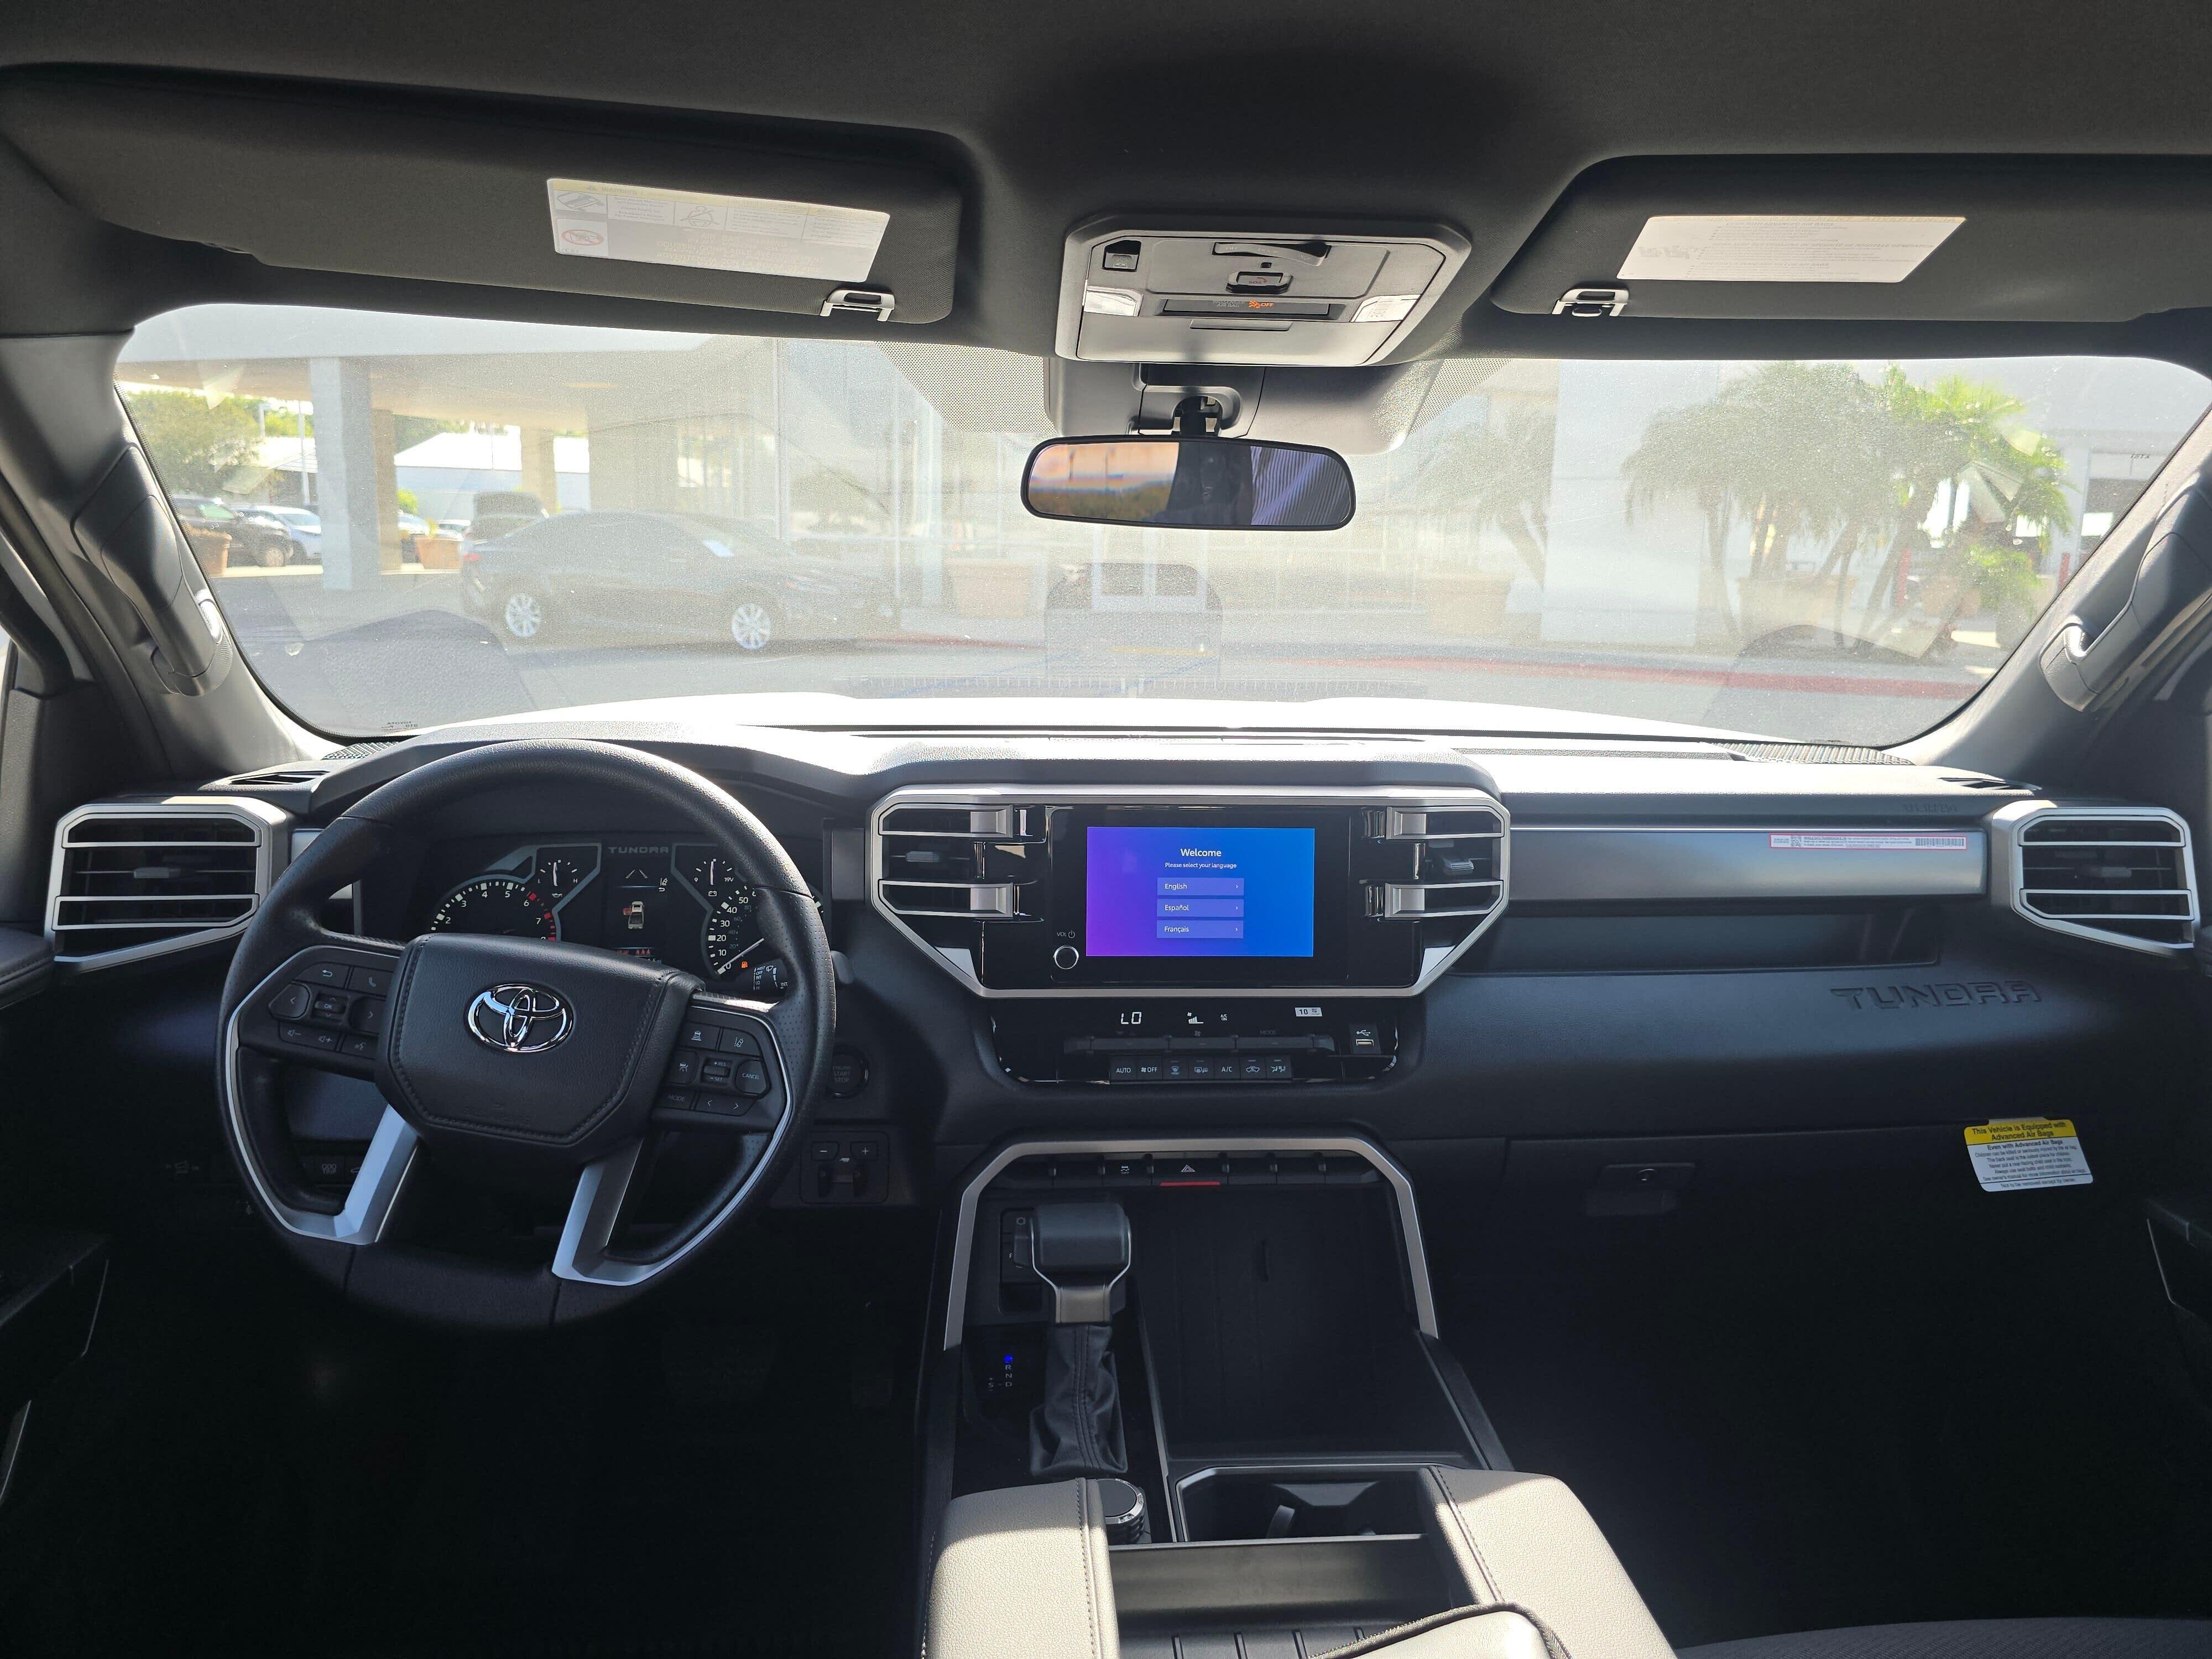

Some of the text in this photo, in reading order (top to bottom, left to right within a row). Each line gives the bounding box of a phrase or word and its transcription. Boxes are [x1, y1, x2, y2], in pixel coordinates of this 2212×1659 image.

[747, 238, 788, 248] WARNING
[657, 240, 696, 250] COUSSIN
[700, 245, 753, 257] GONFLABLE
[755, 251, 823, 262] AVERTISSEMENT
[656, 252, 717, 264] ADVERTENCIA
[1180, 848, 1222, 857] Welcome
[1830, 980, 2042, 1010] TUNDRA
[1120, 1011, 1142, 1025] LO
[2021, 1122, 2052, 1131] Equipped
[1991, 1132, 2025, 1141] Advanced
